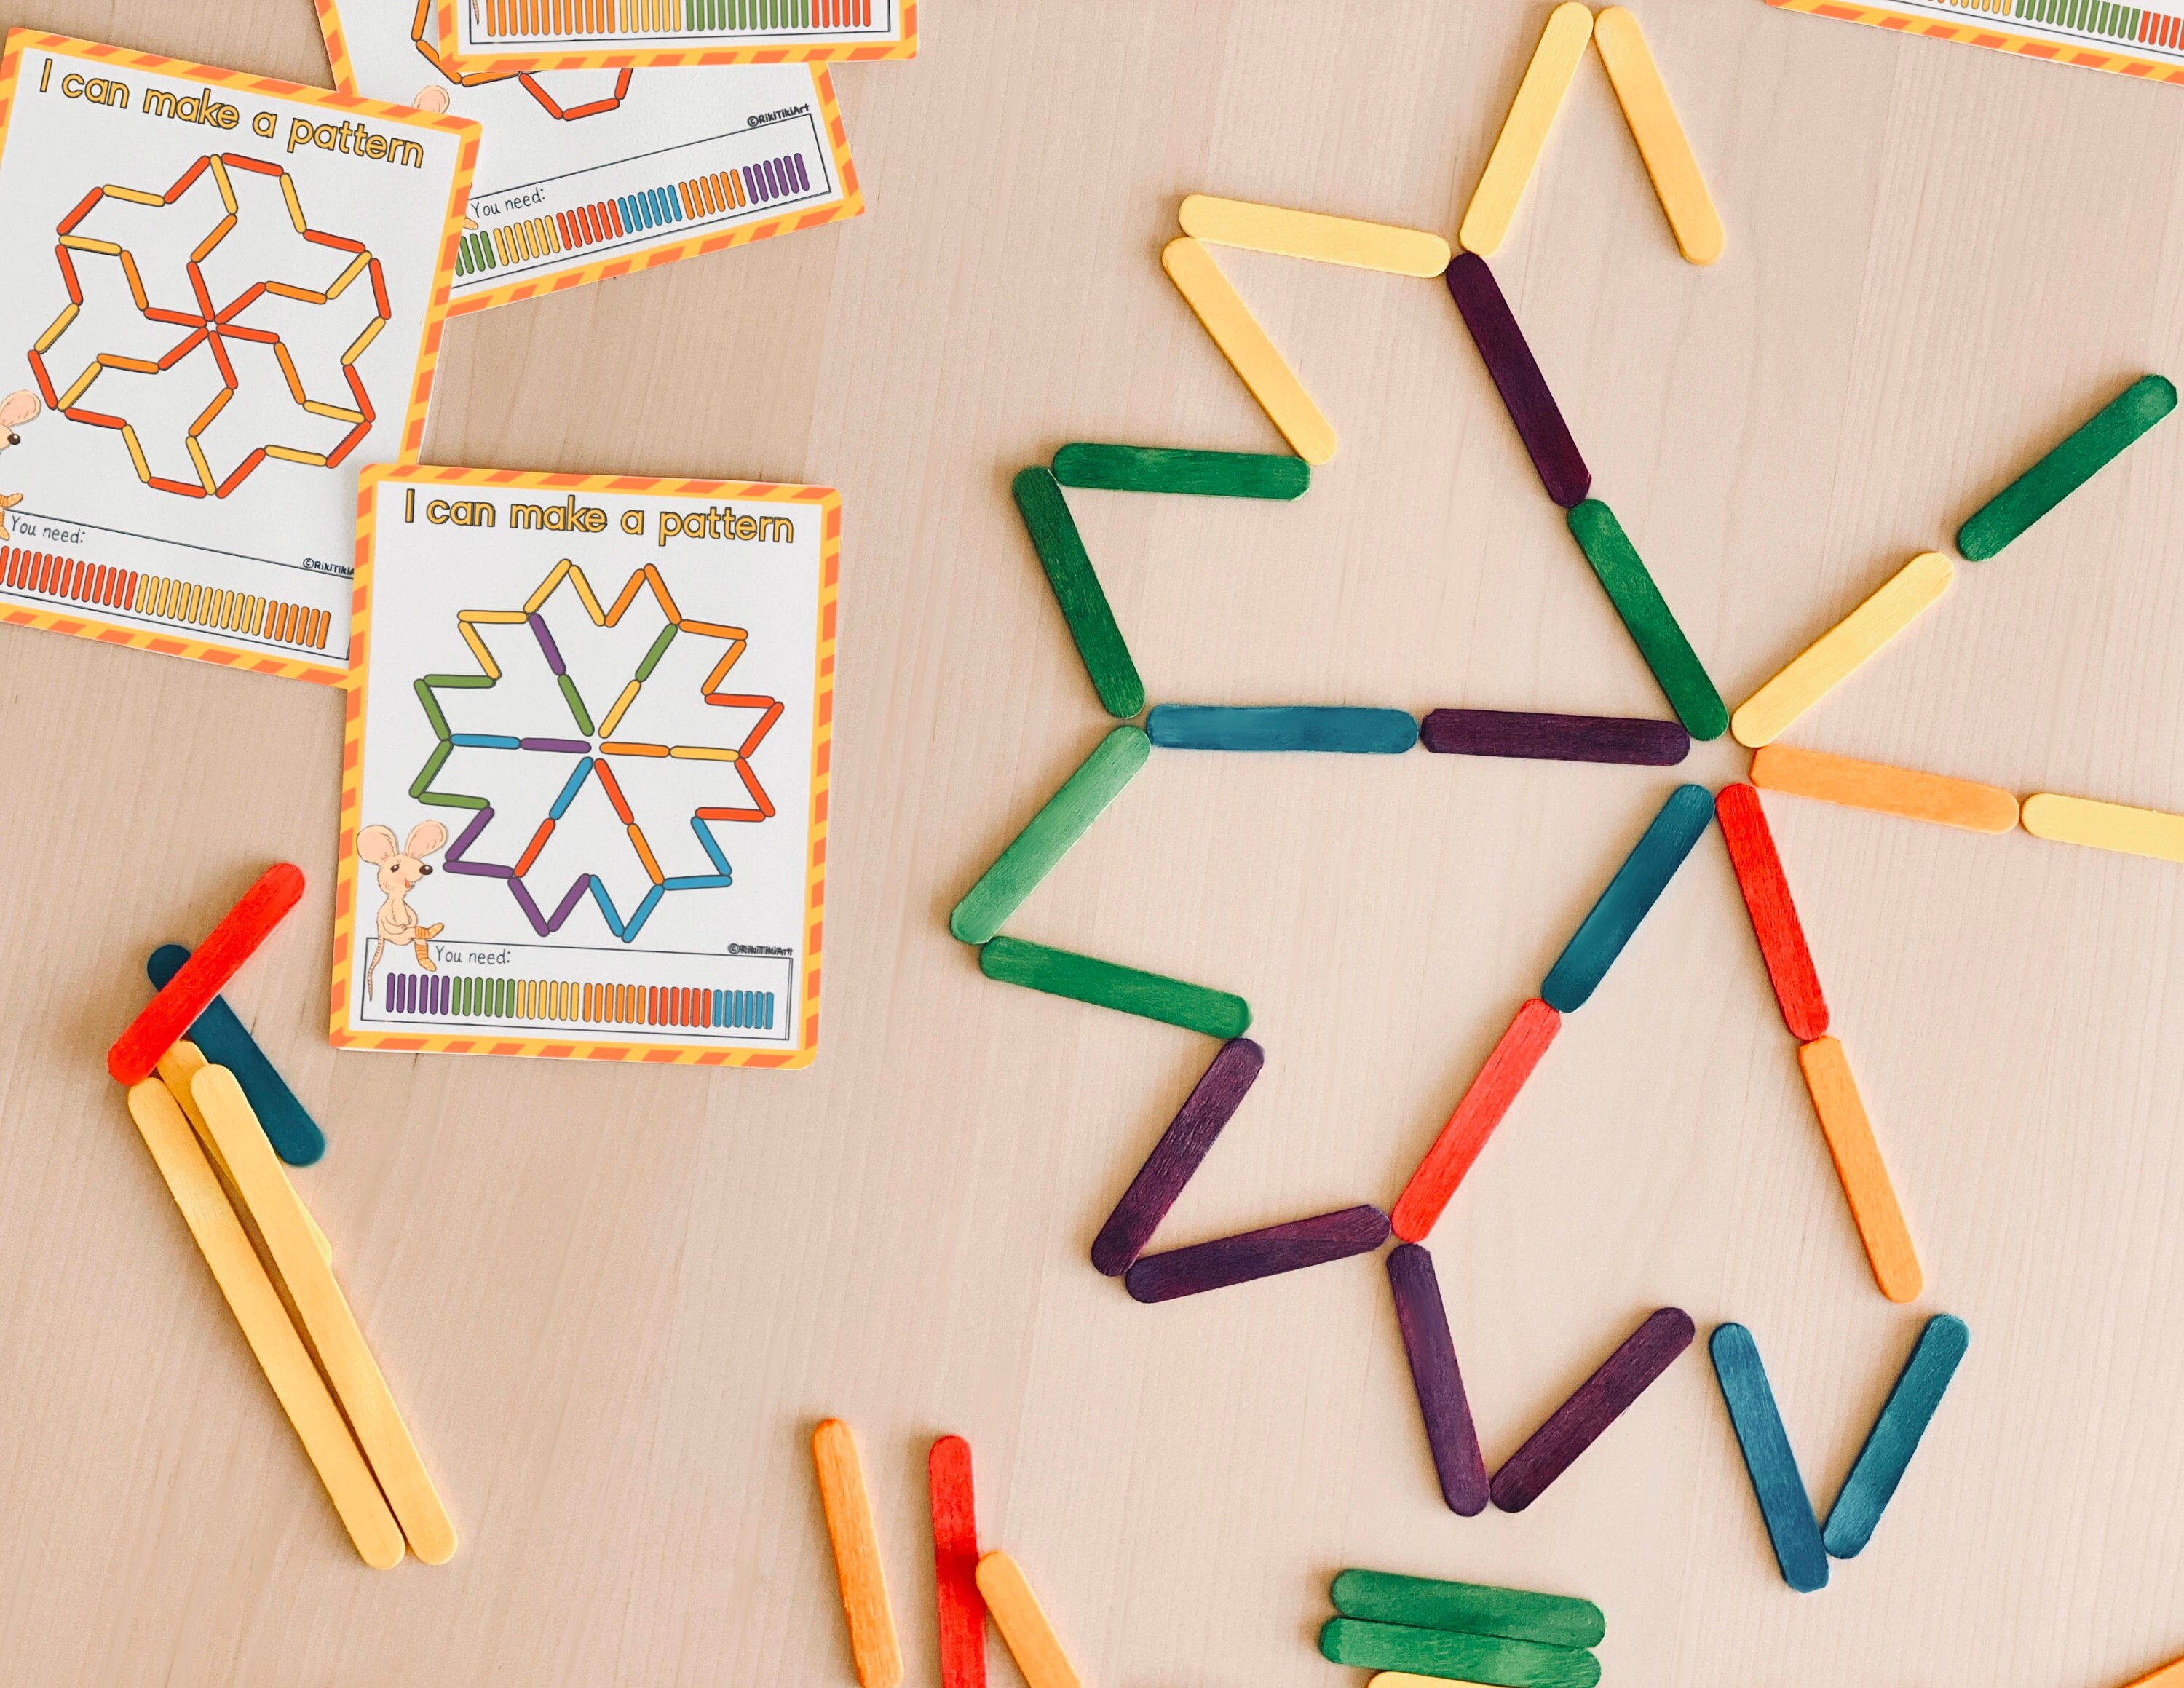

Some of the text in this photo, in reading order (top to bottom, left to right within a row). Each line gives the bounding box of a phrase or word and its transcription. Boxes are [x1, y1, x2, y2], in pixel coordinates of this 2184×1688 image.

[39, 59, 424, 168] I can make a pattern
[470, 186, 545, 218] You need:
[12, 514, 86, 544] You need:
[404, 488, 794, 547] I can make a pattern
[435, 945, 511, 965] You need:
